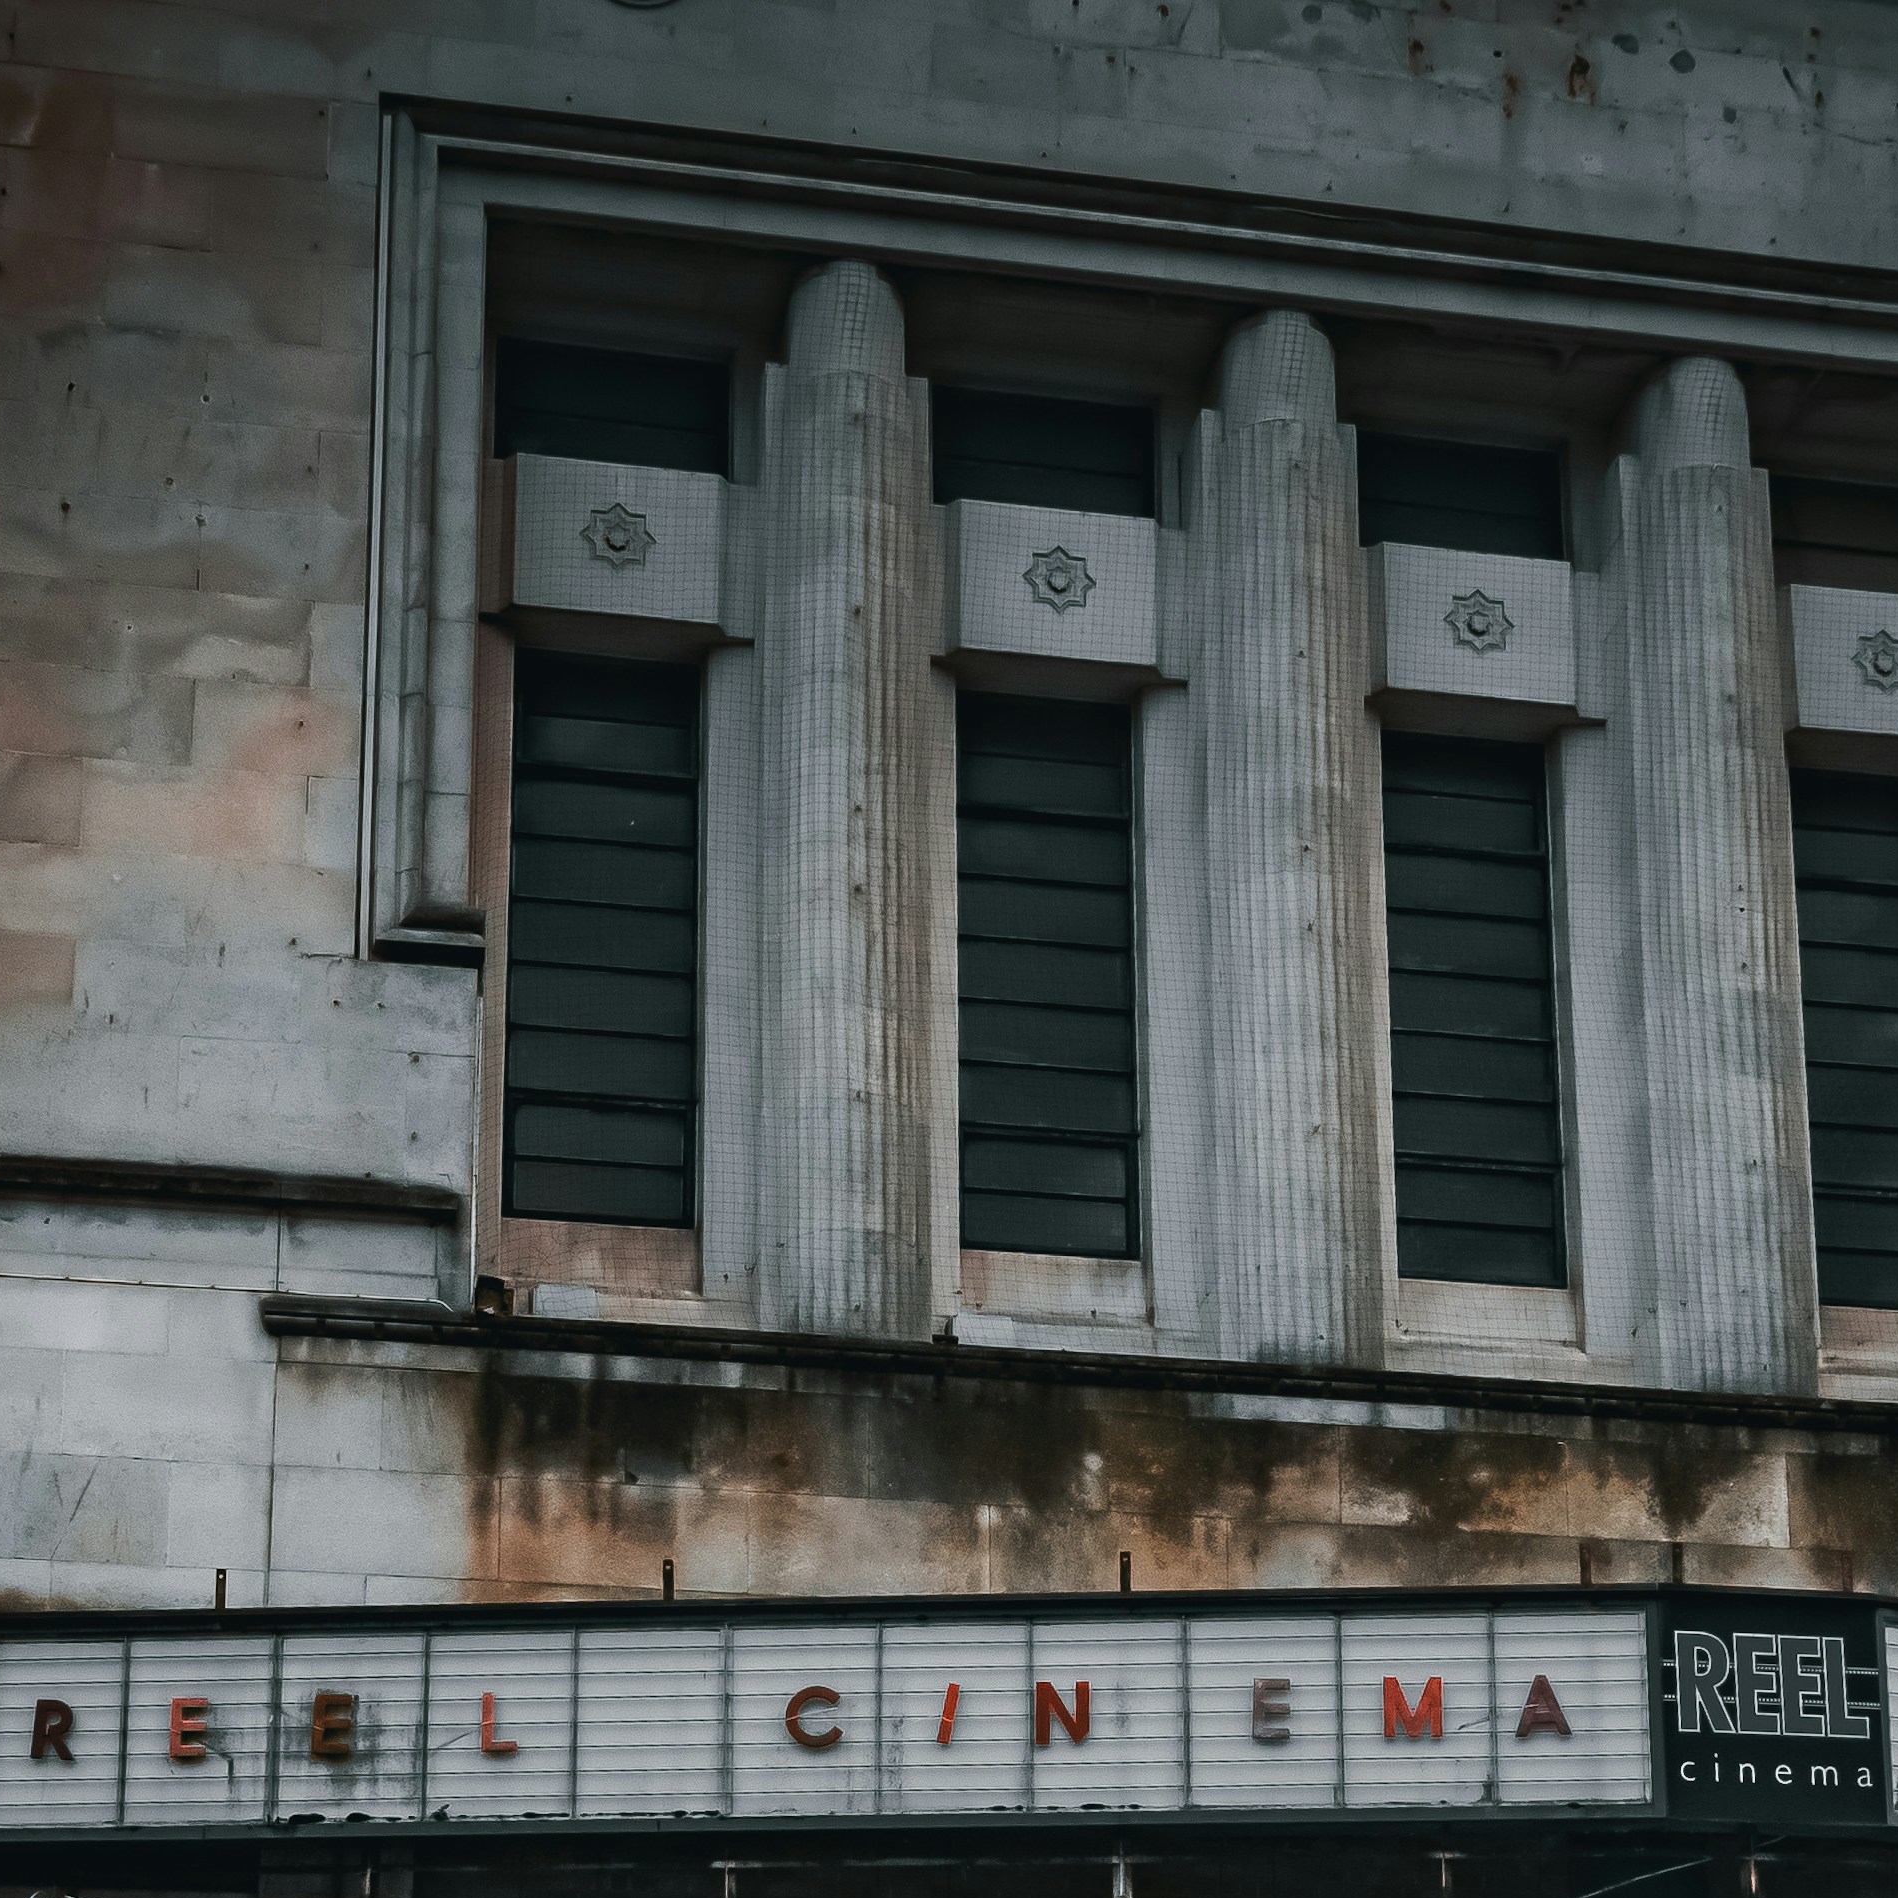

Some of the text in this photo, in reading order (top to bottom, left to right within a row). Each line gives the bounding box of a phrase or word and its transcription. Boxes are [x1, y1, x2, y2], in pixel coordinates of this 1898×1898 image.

[785, 1674, 1573, 1750] CINEMA
[1675, 1630, 1870, 1738] REEL
[1680, 1753, 1873, 1787] cinema
